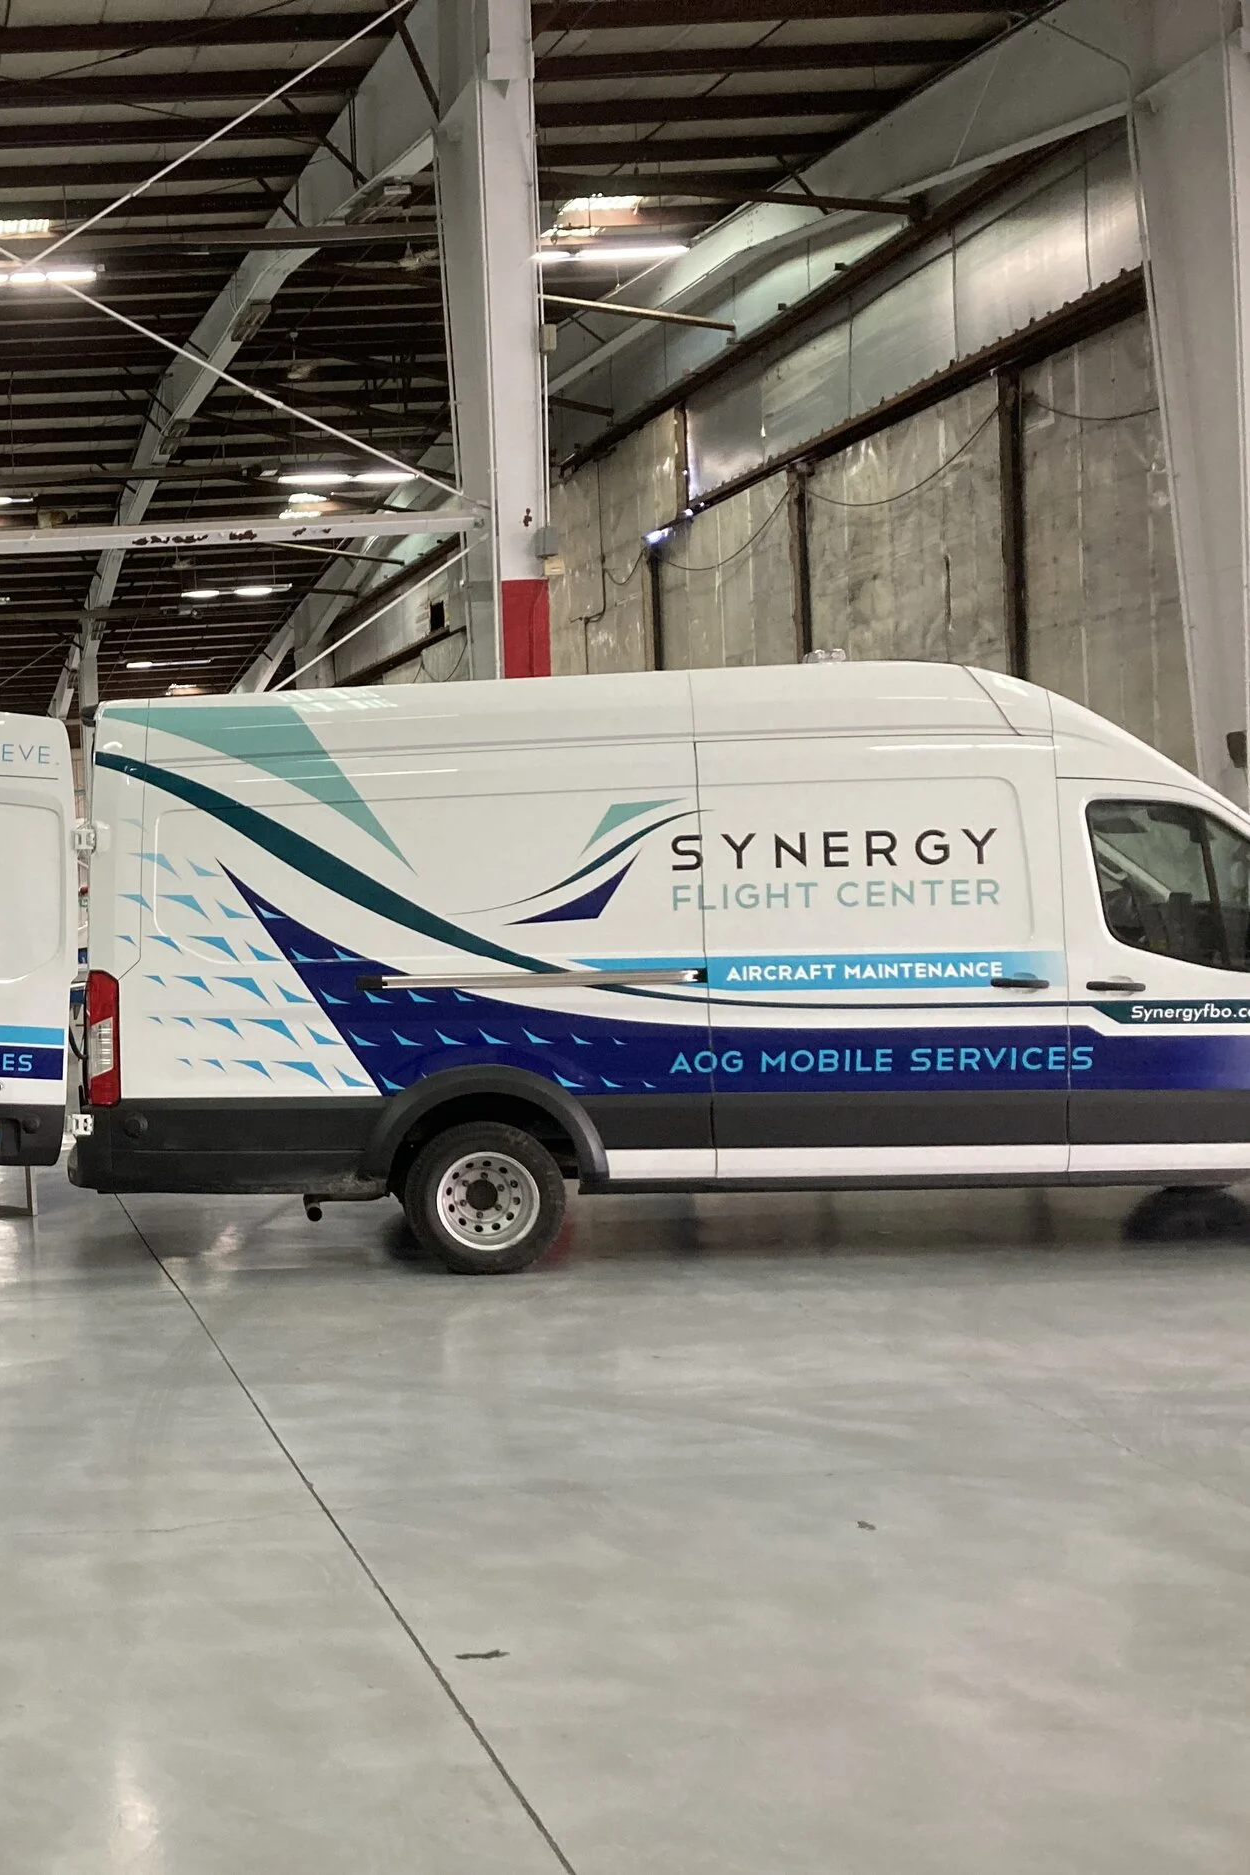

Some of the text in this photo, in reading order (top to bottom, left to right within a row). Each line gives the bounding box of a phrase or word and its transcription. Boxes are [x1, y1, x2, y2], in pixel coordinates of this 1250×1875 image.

[671, 828, 998, 871] SYNERGY
[672, 878, 1000, 912] FLIGHT CENTER
[726, 961, 1004, 983] AIRCRAFT MAINTENANCE
[669, 1046, 1095, 1075] AOG MOBILE SERVICES
